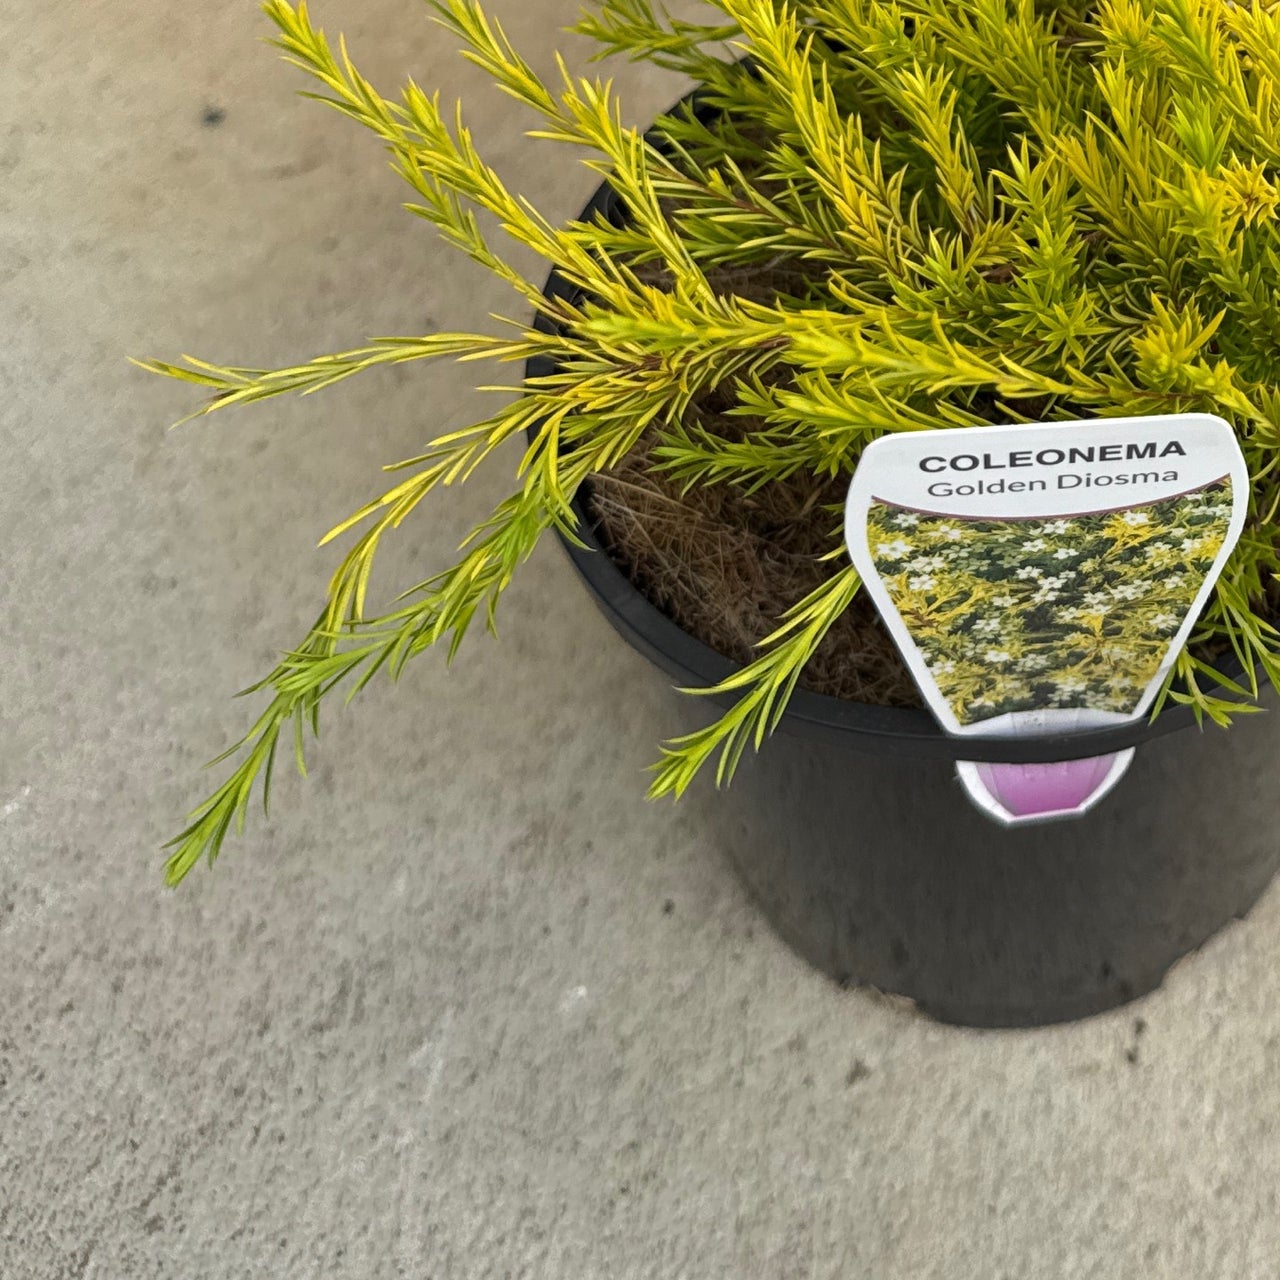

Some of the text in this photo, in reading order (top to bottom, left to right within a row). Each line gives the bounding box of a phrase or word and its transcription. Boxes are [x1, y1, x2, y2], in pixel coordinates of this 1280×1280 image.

[919, 440, 1187, 474] COLEONEMA
[927, 468, 1179, 498] Golden Diosma
